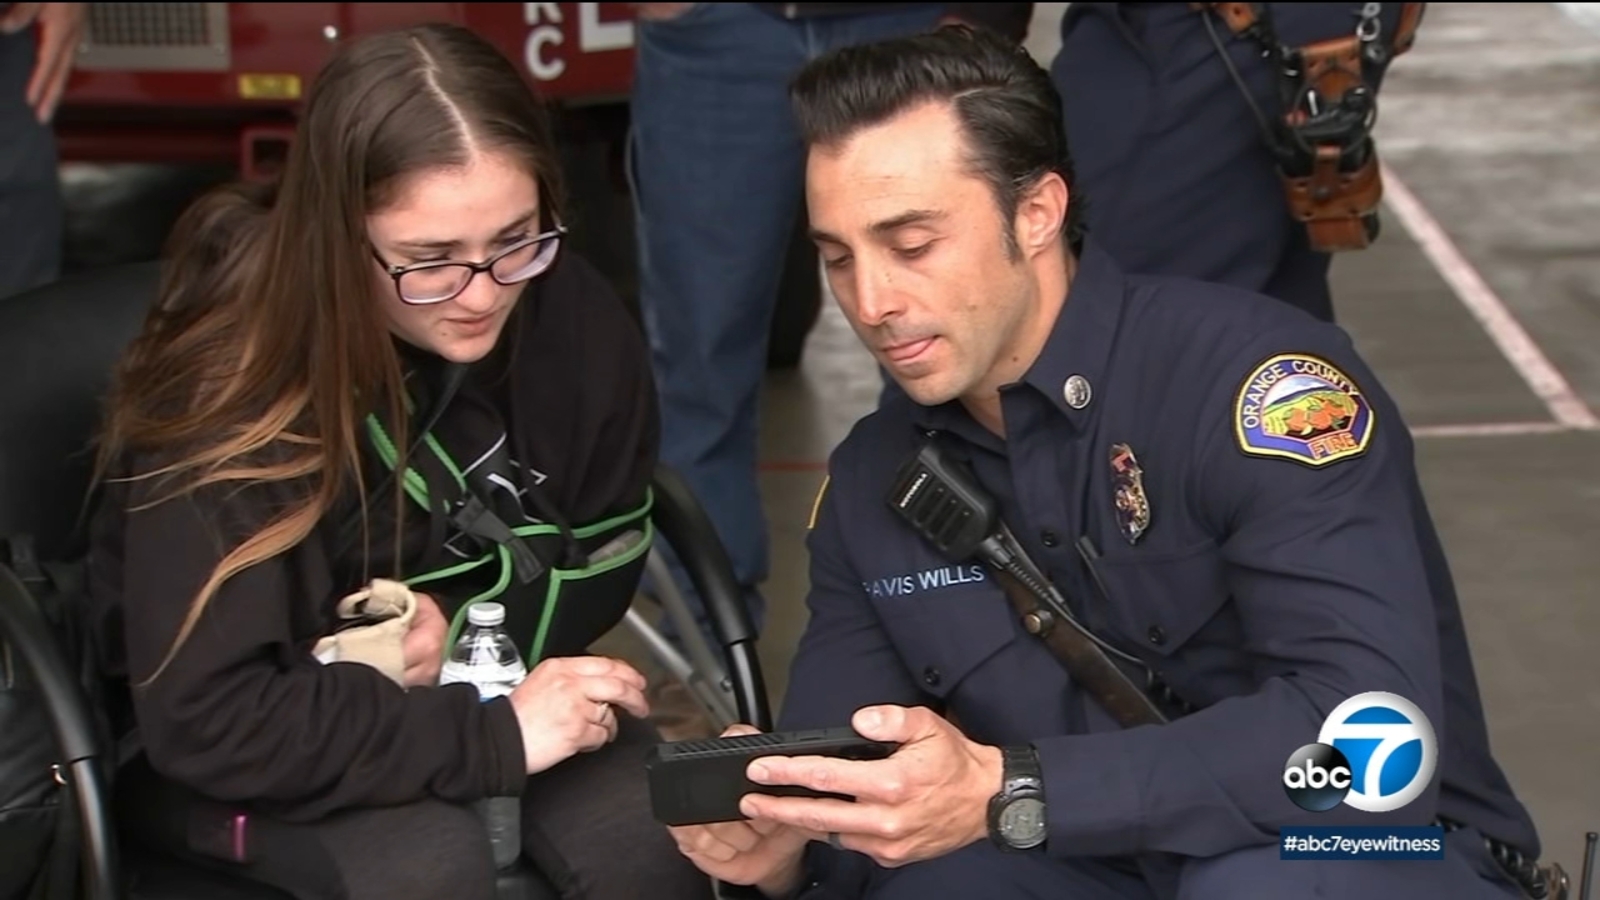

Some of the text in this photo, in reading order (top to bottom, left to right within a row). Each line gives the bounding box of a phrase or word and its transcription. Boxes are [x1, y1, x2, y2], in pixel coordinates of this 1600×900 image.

[1243, 360, 1360, 429] ORANGE COUNTY
[1308, 432, 1359, 460] FIRE
[917, 565, 985, 590] WILLS
